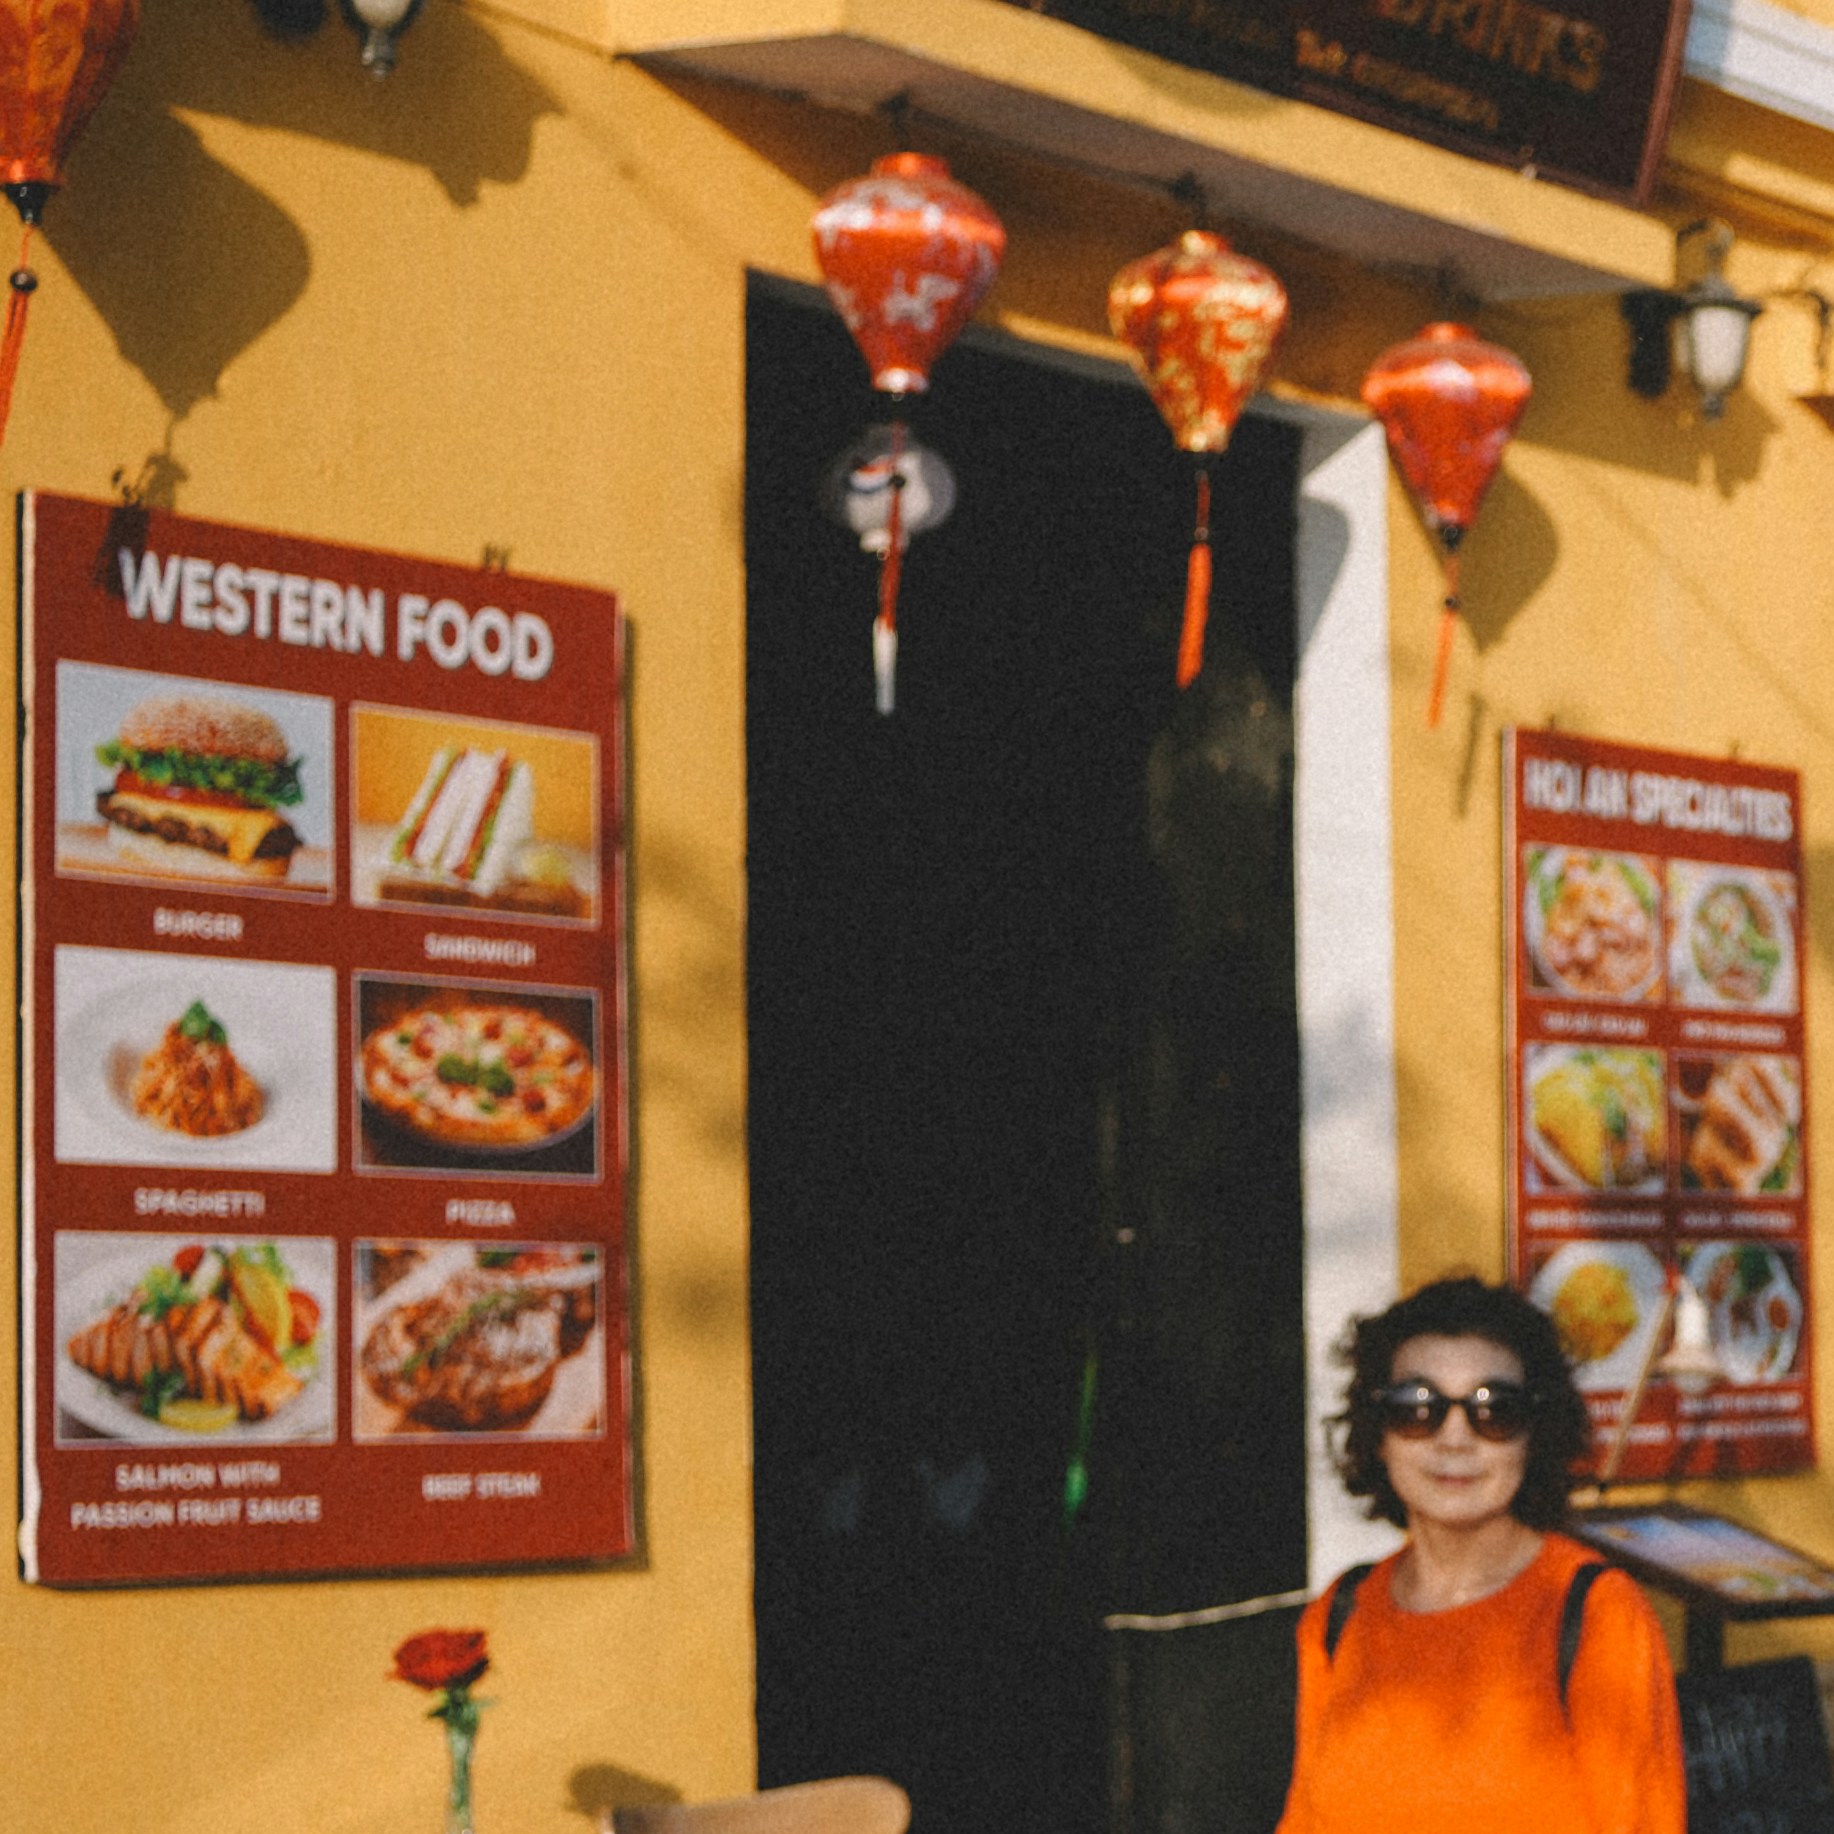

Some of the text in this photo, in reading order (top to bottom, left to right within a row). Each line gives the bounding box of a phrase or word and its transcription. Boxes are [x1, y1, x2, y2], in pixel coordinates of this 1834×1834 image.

[119, 547, 555, 681] WESTERN FOOD
[1584, 765, 1629, 821] AN
[153, 906, 244, 942] BURGER
[424, 931, 535, 967] SANDWICH
[134, 1186, 266, 1218] SPAGHETTI
[445, 1198, 517, 1227] PIZZA
[115, 1461, 281, 1491] SALMON WITH
[422, 1471, 541, 1501] BEEF STEAK
[71, 1495, 321, 1530] PASSION FRUIT SAUCE
